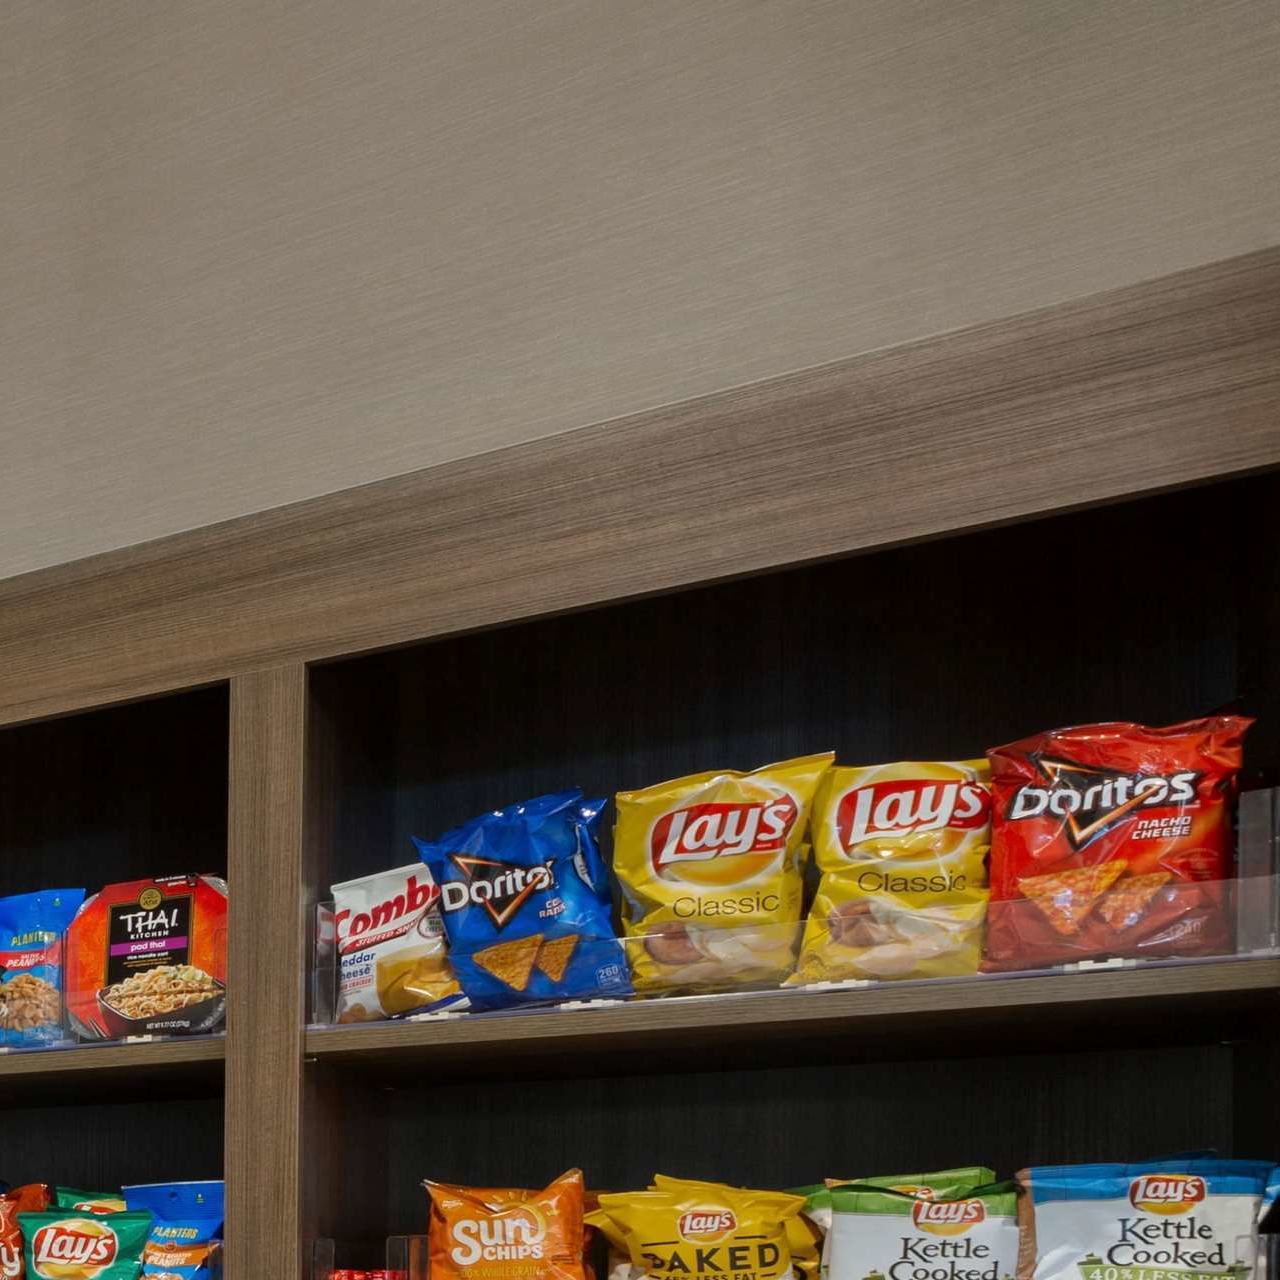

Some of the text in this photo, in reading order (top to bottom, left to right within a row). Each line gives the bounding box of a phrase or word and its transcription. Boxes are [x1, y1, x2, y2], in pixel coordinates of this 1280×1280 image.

[1009, 772, 1198, 820] Doritos
[848, 775, 984, 847] Lay's
[1137, 815, 1191, 829] NACHO
[659, 798, 793, 865] Lay's
[1131, 826, 1191, 840] CHEESE
[857, 870, 967, 894] Classic
[672, 891, 780, 919] Classic
[119, 908, 178, 933] THAI
[130, 930, 169, 940] KITCHEN
[131, 940, 165, 952] pad thai
[598, 966, 620, 981] 260
[1135, 1178, 1201, 1203] Lay's
[682, 1210, 731, 1235] Lay's
[917, 1200, 981, 1224] Lay's
[151, 1225, 198, 1239] PLANTERS
[452, 1218, 545, 1265] Sun
[1117, 1217, 1213, 1244] Kettle
[37, 1228, 114, 1265] Lay's
[483, 1244, 544, 1259] CHIPS
[899, 1237, 990, 1264] Kettle
[1107, 1242, 1226, 1268] Cooked
[481, 1265, 539, 1278] WHOLE GRAIN
